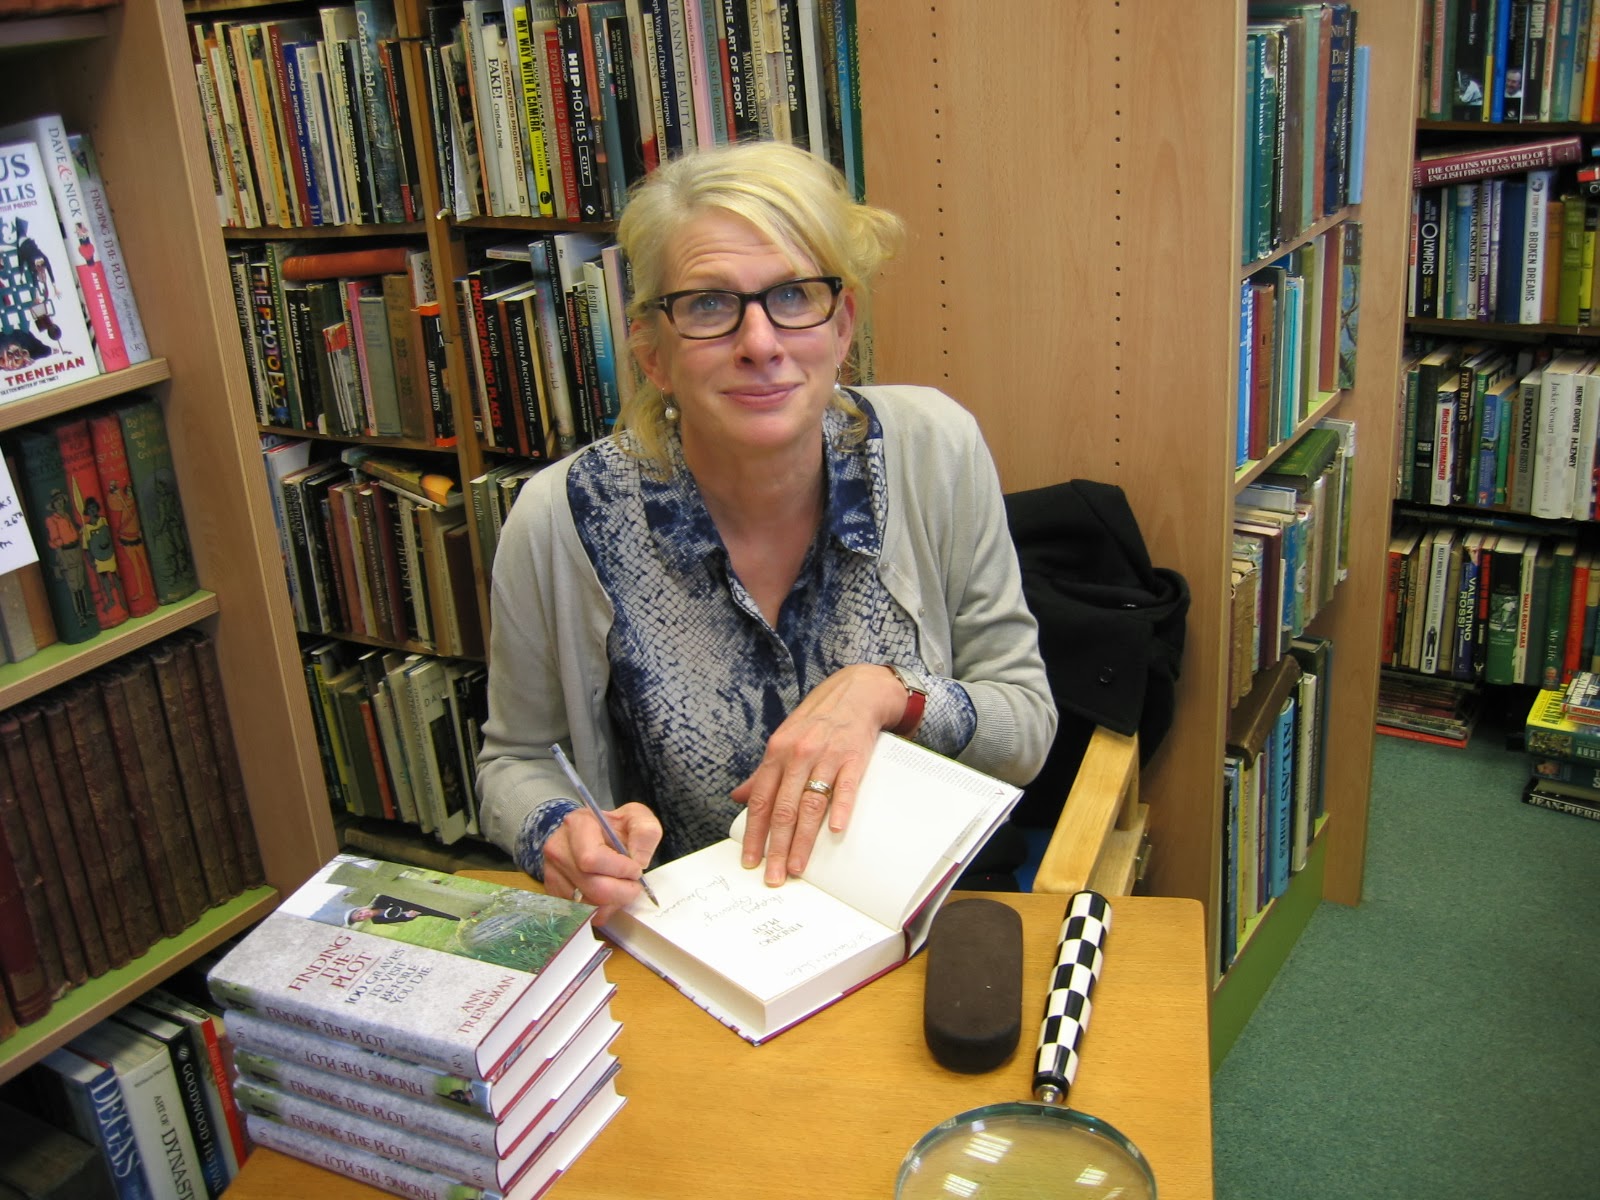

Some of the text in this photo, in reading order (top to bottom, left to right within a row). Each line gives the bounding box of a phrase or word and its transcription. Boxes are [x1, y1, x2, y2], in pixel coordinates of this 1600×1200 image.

[517, 19, 528, 36] MY
[780, 4, 789, 22] The
[783, 24, 791, 41] Art
[1529, 3, 1545, 39] COOPER
[354, 11, 378, 97] Constable
[468, 31, 478, 71] WORKERS
[519, 37, 531, 57] WAY
[594, 32, 603, 57] Textile
[724, 0, 744, 118] THE ART OF SPORT
[784, 43, 792, 54] of
[1259, 41, 1267, 73] TREES
[271, 33, 281, 59] Turner
[277, 69, 288, 104] Germany
[522, 61, 535, 85] WITH
[596, 59, 607, 89] Printing
[743, 51, 758, 123] MOUNTBATTEN
[785, 55, 795, 82] Emile
[488, 57, 505, 149] FAKE! Clifford Irving
[525, 86, 535, 94] A
[286, 62, 312, 187] SCHWENK Sensitive Chaos
[506, 79, 515, 119] PAINTER'S
[511, 120, 520, 158] PROBLEM
[516, 159, 524, 182] BOOK
[527, 96, 540, 132] CAMERA
[548, 48, 574, 199] WITNESS IMAGES OF THE DECADE
[568, 53, 589, 176] HIP HOTELS CITY
[1256, 102, 1266, 145] SHRUBS
[1427, 151, 1544, 175] THE COLLINS WHO'S WHO OF
[1428, 158, 1545, 183] ENGLISH FIRST-CLASS CRICKET
[13, 200, 38, 210] POLITICS
[1471, 188, 1480, 217] WORLD
[48, 127, 116, 340] DAVE & NICK ANN TRENEMAN
[90, 188, 126, 290] FINDING THE PLOT
[1471, 218, 1478, 229] OF
[1419, 223, 1438, 275] OLYMPICS
[1470, 230, 1478, 264] CRICKET
[1527, 231, 1538, 265] BROKEN
[1525, 267, 1537, 302] DREAMS
[288, 302, 303, 354] African Art
[486, 315, 500, 357] Van Gogh
[4, 356, 85, 387] TRENEMAN
[470, 279, 502, 428] PHOTOGRAPHING PLACES
[514, 316, 538, 423] WESTERN ARCHITECTURE
[428, 359, 440, 412] ART AND ARTISTS
[1458, 371, 1470, 422] TEN BEARS
[1525, 387, 1535, 397] THE
[1519, 397, 1534, 449] BOXING
[1547, 382, 1560, 434] Jackie Stewart
[1436, 408, 1451, 481] Michael SCHUMACHER
[472, 488, 485, 521] Murillo
[1457, 590, 1468, 628] ROSSI
[1463, 577, 1477, 641] VALENTINO
[1518, 593, 1531, 649] SMALL BOAT SAILS
[1547, 629, 1559, 662] My Life
[752, 917, 780, 935] PLOT
[759, 922, 803, 947] FINDING
[761, 924, 785, 936] THE
[288, 935, 352, 992] FINDING
[319, 952, 352, 979] THE
[332, 951, 373, 989] PLOT
[345, 948, 405, 1005] 100 GRAVES
[369, 963, 405, 997] TO VISIT
[380, 964, 418, 1001] BEFORE
[390, 966, 432, 1004] YOU DIE
[460, 989, 487, 1012] ANN
[457, 975, 516, 1035] TRENEMAN
[266, 1006, 385, 1049] FINDING THE PLOT
[305, 1050, 424, 1096] FINDING THE PLOT
[290, 1080, 406, 1126] FINDING THE PLOT
[90, 1075, 140, 1179] DEGAS
[182, 1063, 223, 1193] GOODWOOD FESTIVAL
[290, 1114, 407, 1159] FINDING THE PLOT
[323, 1153, 437, 1200] FINDING THE PLOT
